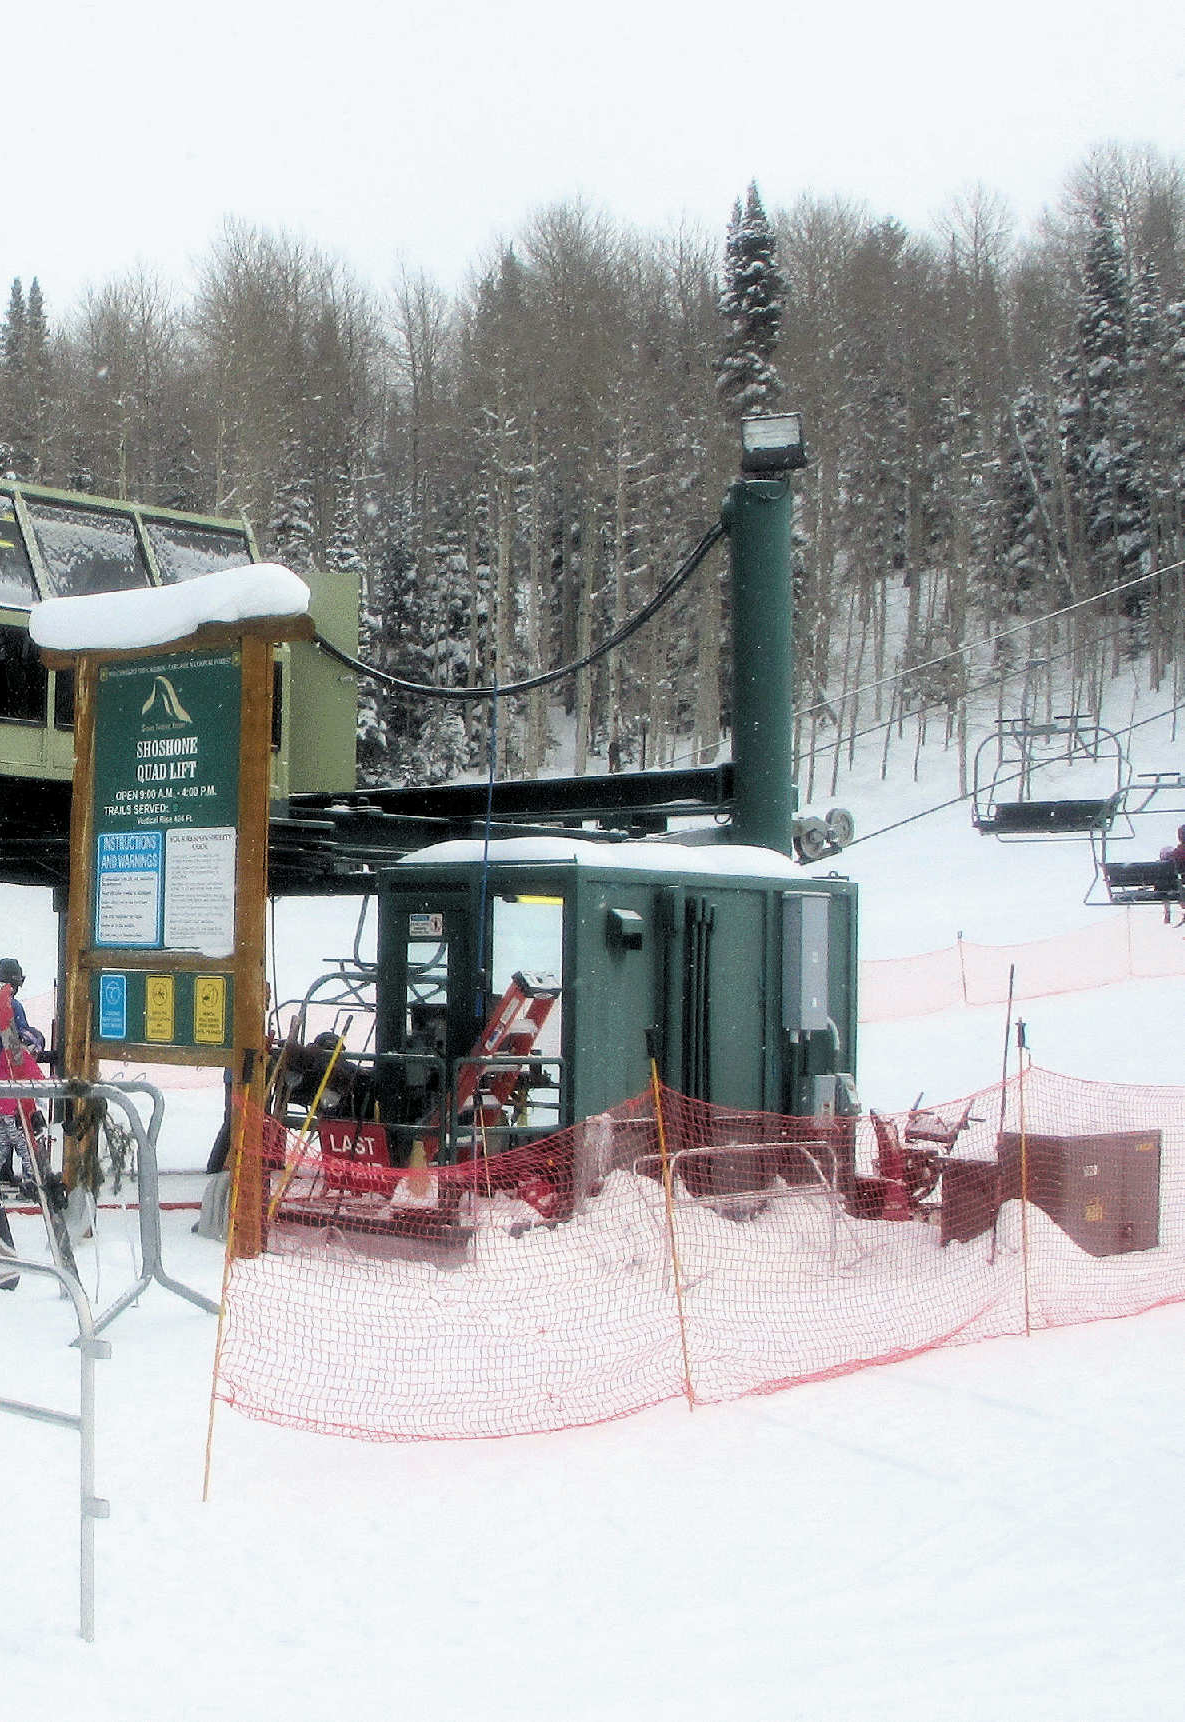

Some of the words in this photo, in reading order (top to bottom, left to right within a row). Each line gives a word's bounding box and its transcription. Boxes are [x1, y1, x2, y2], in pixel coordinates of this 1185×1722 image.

[136, 736, 199, 758] SHOSHONE
[137, 763, 166, 783] QUAD
[169, 760, 197, 780] LIFT
[116, 790, 138, 801] OPEN
[138, 789, 156, 800] 9:00
[182, 786, 199, 797] 4:00
[200, 785, 217, 796] P.M.
[104, 804, 132, 817] TRAILS
[134, 803, 170, 815] SERVED:
[103, 835, 157, 851] INSTRUCTIONS
[101, 855, 118, 869] AND
[118, 853, 157, 869] WARNINGS
[329, 1134, 375, 1156] LAST
